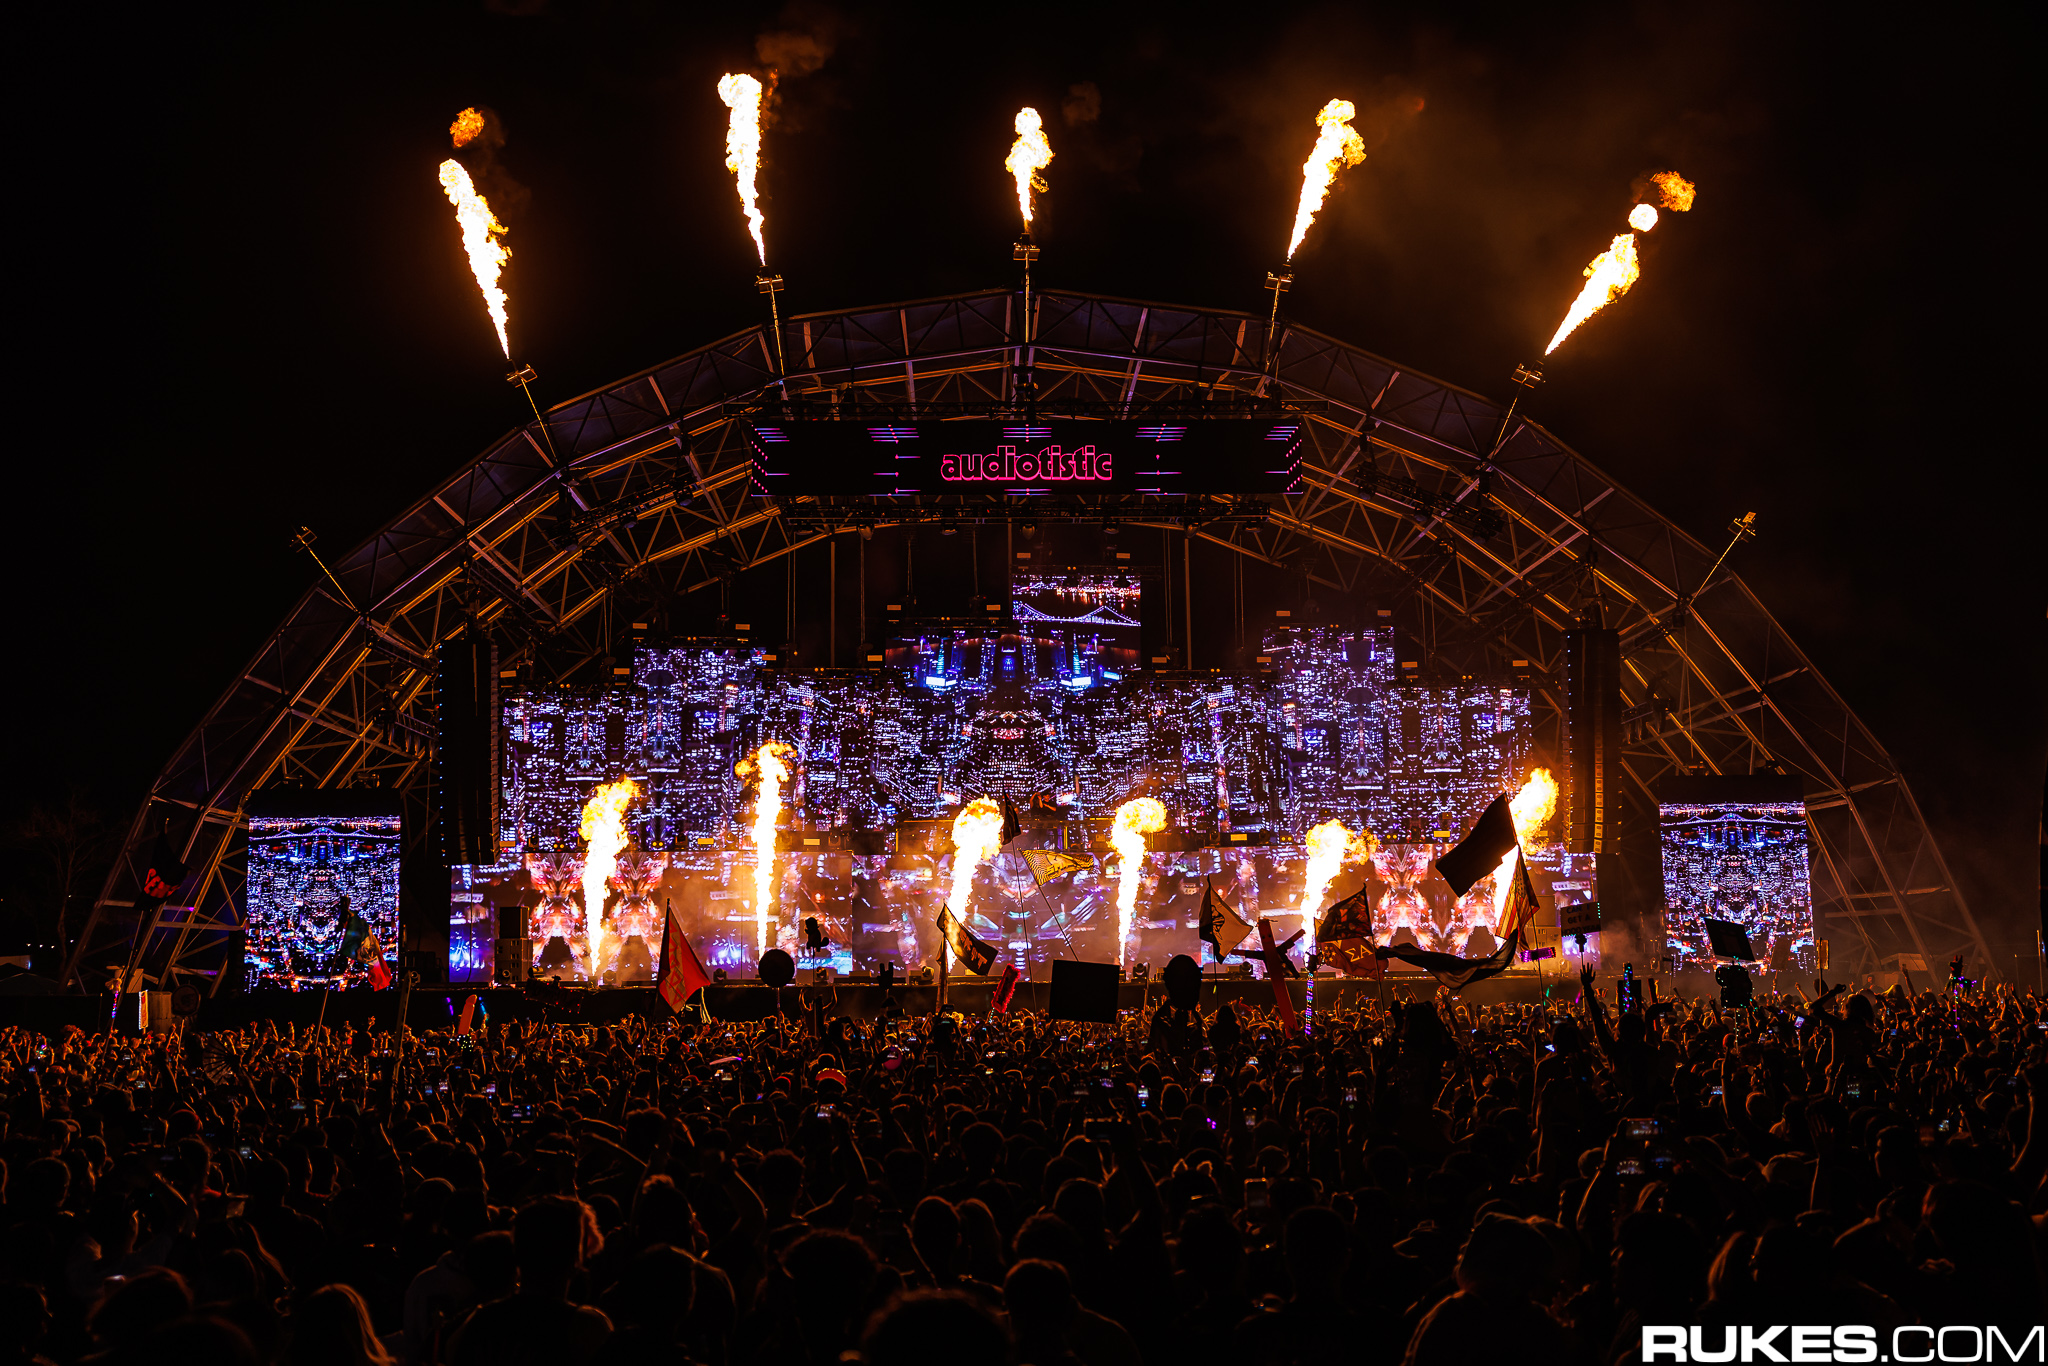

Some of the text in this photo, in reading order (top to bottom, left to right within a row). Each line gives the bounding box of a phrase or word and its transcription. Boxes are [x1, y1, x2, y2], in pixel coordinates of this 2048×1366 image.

[940, 445, 1112, 481] audiotistic
[1567, 905, 1582, 914] CAN
[1568, 915, 1582, 924] GET
